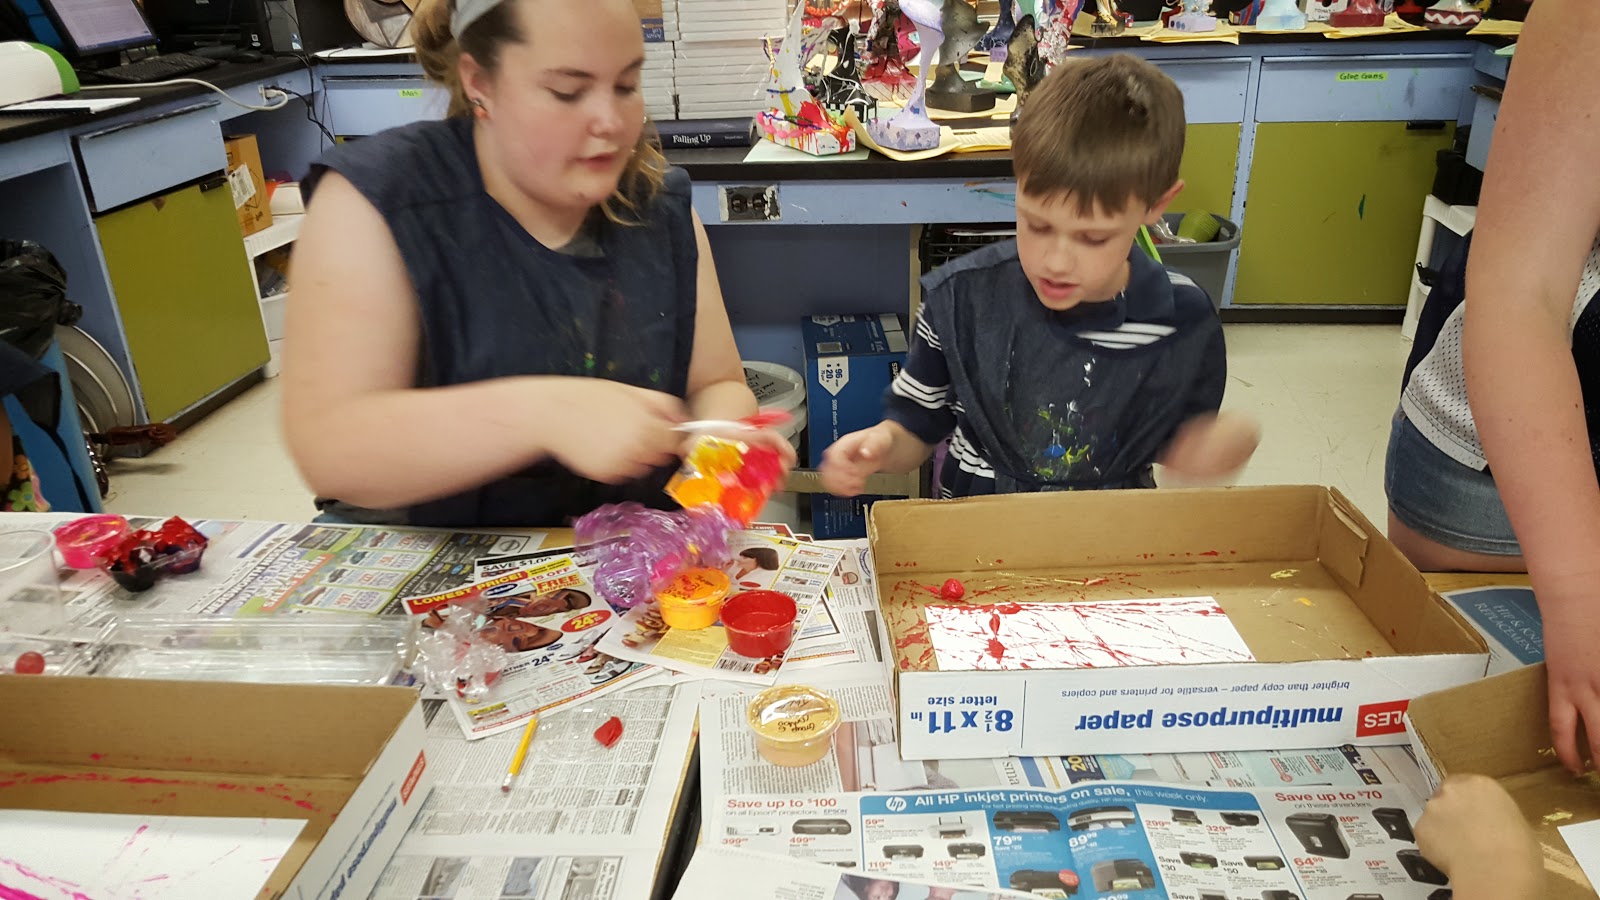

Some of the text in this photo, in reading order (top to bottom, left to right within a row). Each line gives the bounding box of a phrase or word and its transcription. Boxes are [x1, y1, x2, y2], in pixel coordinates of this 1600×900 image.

[1340, 72, 1384, 80] Glue Guns
[672, 134, 712, 145] Falling Up
[826, 368, 834, 379] 20
[835, 368, 843, 379] 96
[482, 562, 516, 571] SAVE
[547, 567, 570, 577] OFF
[537, 574, 578, 590] FREE
[413, 588, 473, 605] LOWEST
[476, 571, 523, 591] PRICE!
[1177, 686, 1218, 695] versatile
[1230, 683, 1259, 692] paper
[1261, 684, 1285, 692] copy
[1287, 683, 1309, 691] than
[1311, 681, 1350, 690] brighter
[1061, 690, 1097, 698] copiers
[1099, 689, 1117, 697] and
[1120, 687, 1158, 696] printers
[1160, 687, 1174, 695] for
[928, 696, 998, 706] letter size
[910, 712, 923, 722] in
[1074, 706, 1343, 731] multipurpose paper
[928, 711, 956, 734] 11
[915, 796, 934, 806] All
[938, 794, 960, 805] HP
[964, 792, 1006, 804] inkjet
[1009, 792, 1068, 804] printers
[1071, 788, 1091, 800] on
[1094, 786, 1130, 796] sale,
[1135, 788, 1154, 797] this
[1155, 791, 1184, 800] week
[1275, 790, 1383, 802] Save up to $70
[727, 798, 837, 809] Save up to $100
[1158, 856, 1180, 864] Save
